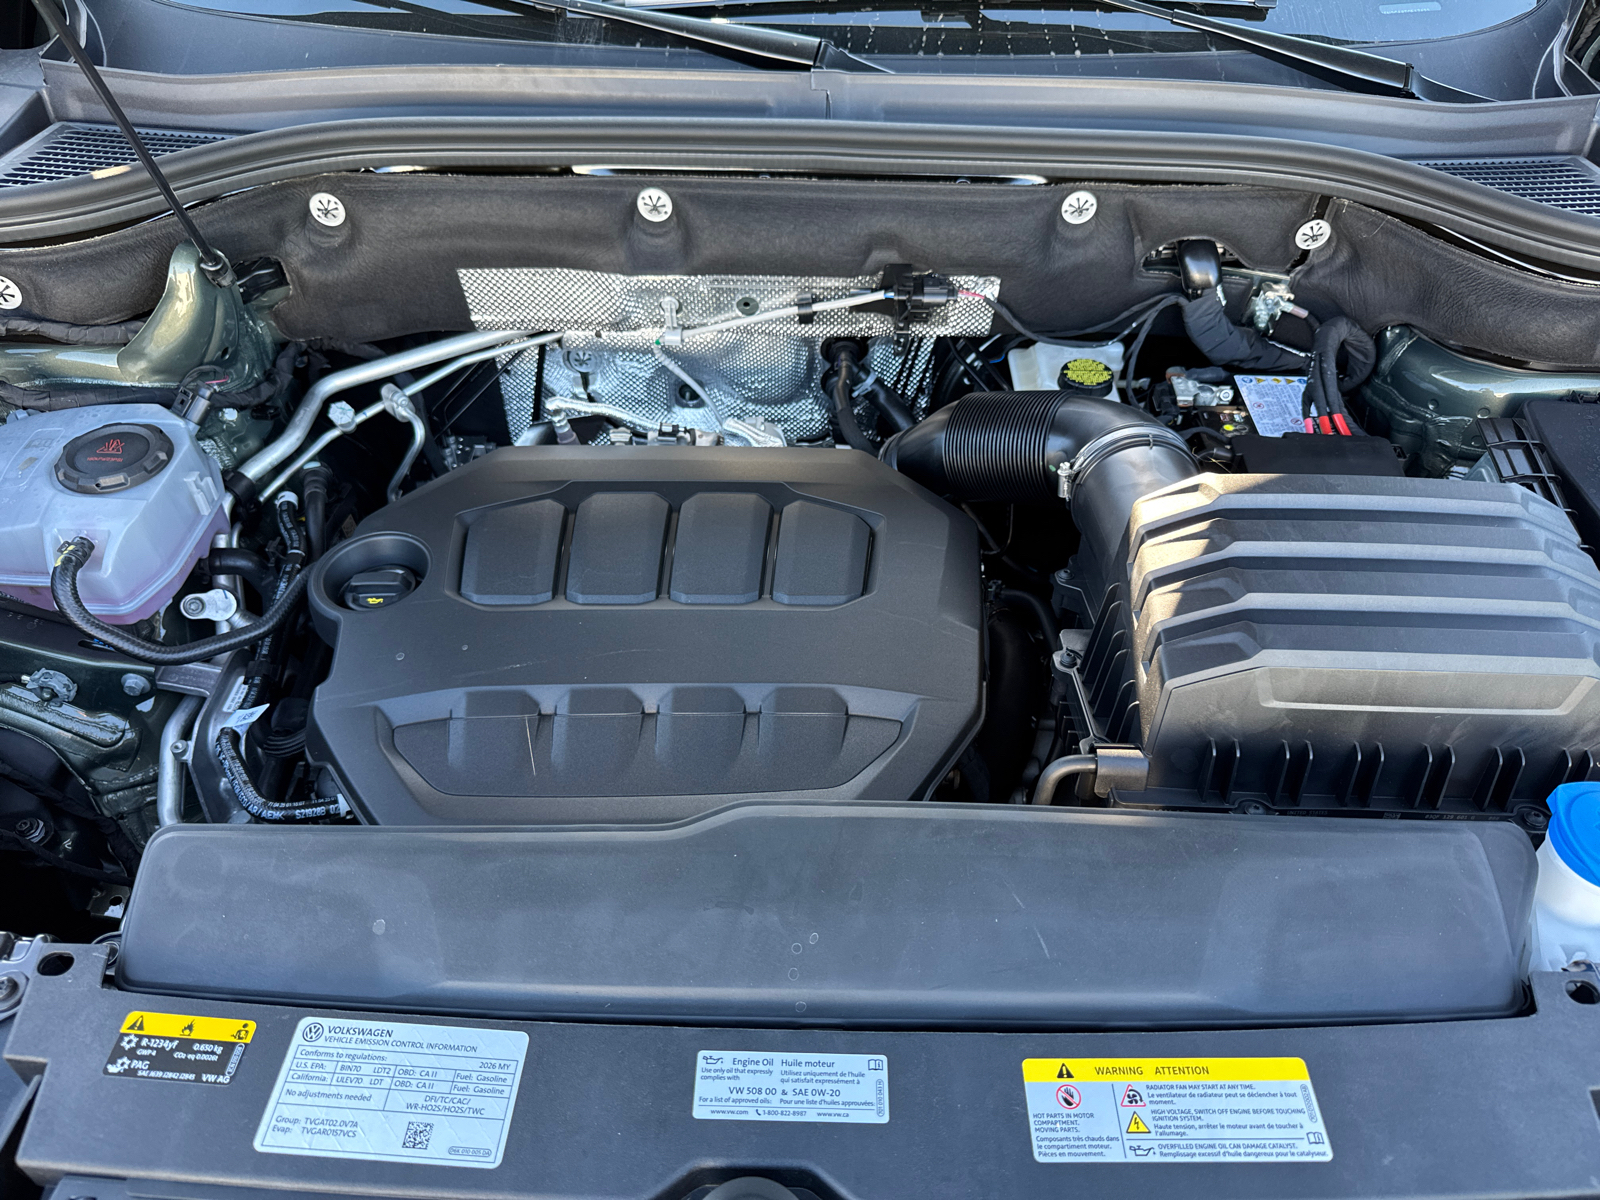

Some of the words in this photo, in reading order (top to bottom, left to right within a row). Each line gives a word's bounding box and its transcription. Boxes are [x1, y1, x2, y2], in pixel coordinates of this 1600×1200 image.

[328, 1026, 393, 1038] VOLKSWAGEN
[140, 1038, 179, 1050] R-1234yf
[192, 1043, 214, 1052] 0.650
[214, 1045, 224, 1054] kg
[324, 1036, 353, 1044] VEHICLE
[354, 1038, 389, 1046] EMISSION
[391, 1040, 424, 1048] CONTROL
[426, 1042, 478, 1052] INFORMATION
[300, 1049, 334, 1058] Conforms
[344, 1052, 387, 1062] regulations:
[130, 1060, 150, 1070] PAG
[732, 1058, 760, 1067] Engine
[762, 1058, 774, 1066] Oil
[781, 1059, 802, 1067] Huile
[1095, 1066, 1143, 1075] WARNING
[1155, 1066, 1209, 1075] ATTENTION
[202, 1074, 217, 1082] VW
[217, 1076, 230, 1084] AG
[291, 1072, 328, 1082] California:
[336, 1076, 363, 1084] ULEV70
[476, 1074, 508, 1083] Gasoline
[298, 1090, 343, 1100] adjustments
[474, 1086, 504, 1094] Gasoline
[728, 1086, 744, 1095] VW
[746, 1087, 762, 1095] 508
[765, 1088, 777, 1096] 00
[811, 1089, 840, 1097] 0W-20
[424, 1095, 471, 1105] DFI/TC/CAC/
[406, 1102, 486, 1116] WR-HO2S/HO2S/TWC
[276, 1116, 300, 1126] Group:
[304, 1118, 358, 1128] TVGAT02.0V7A
[272, 1124, 293, 1134] Evap:
